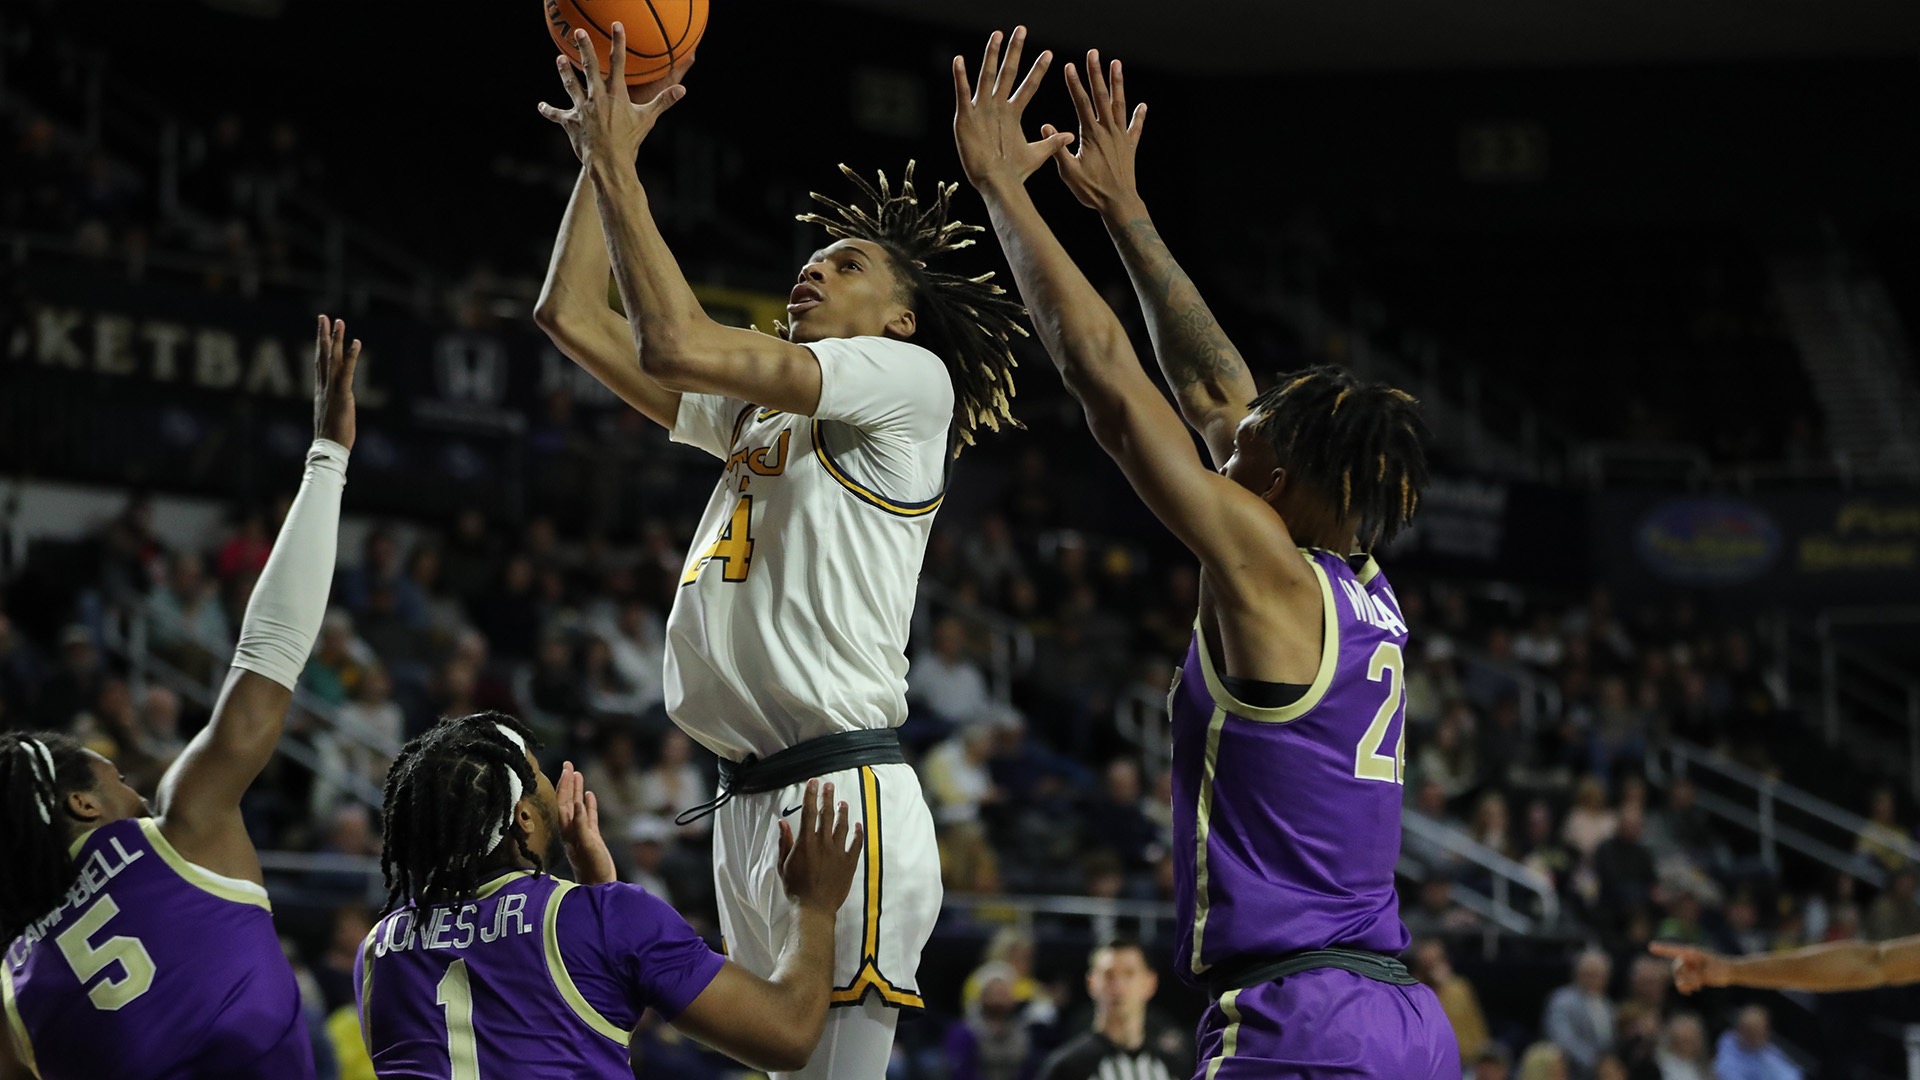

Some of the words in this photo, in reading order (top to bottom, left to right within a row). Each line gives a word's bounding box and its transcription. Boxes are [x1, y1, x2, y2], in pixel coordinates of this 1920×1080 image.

[1354, 640, 1407, 785] 2
[55, 893, 157, 1011] 5
[374, 903, 478, 959] JONES
[480, 893, 533, 943] JR.
[436, 957, 481, 1080] 1
